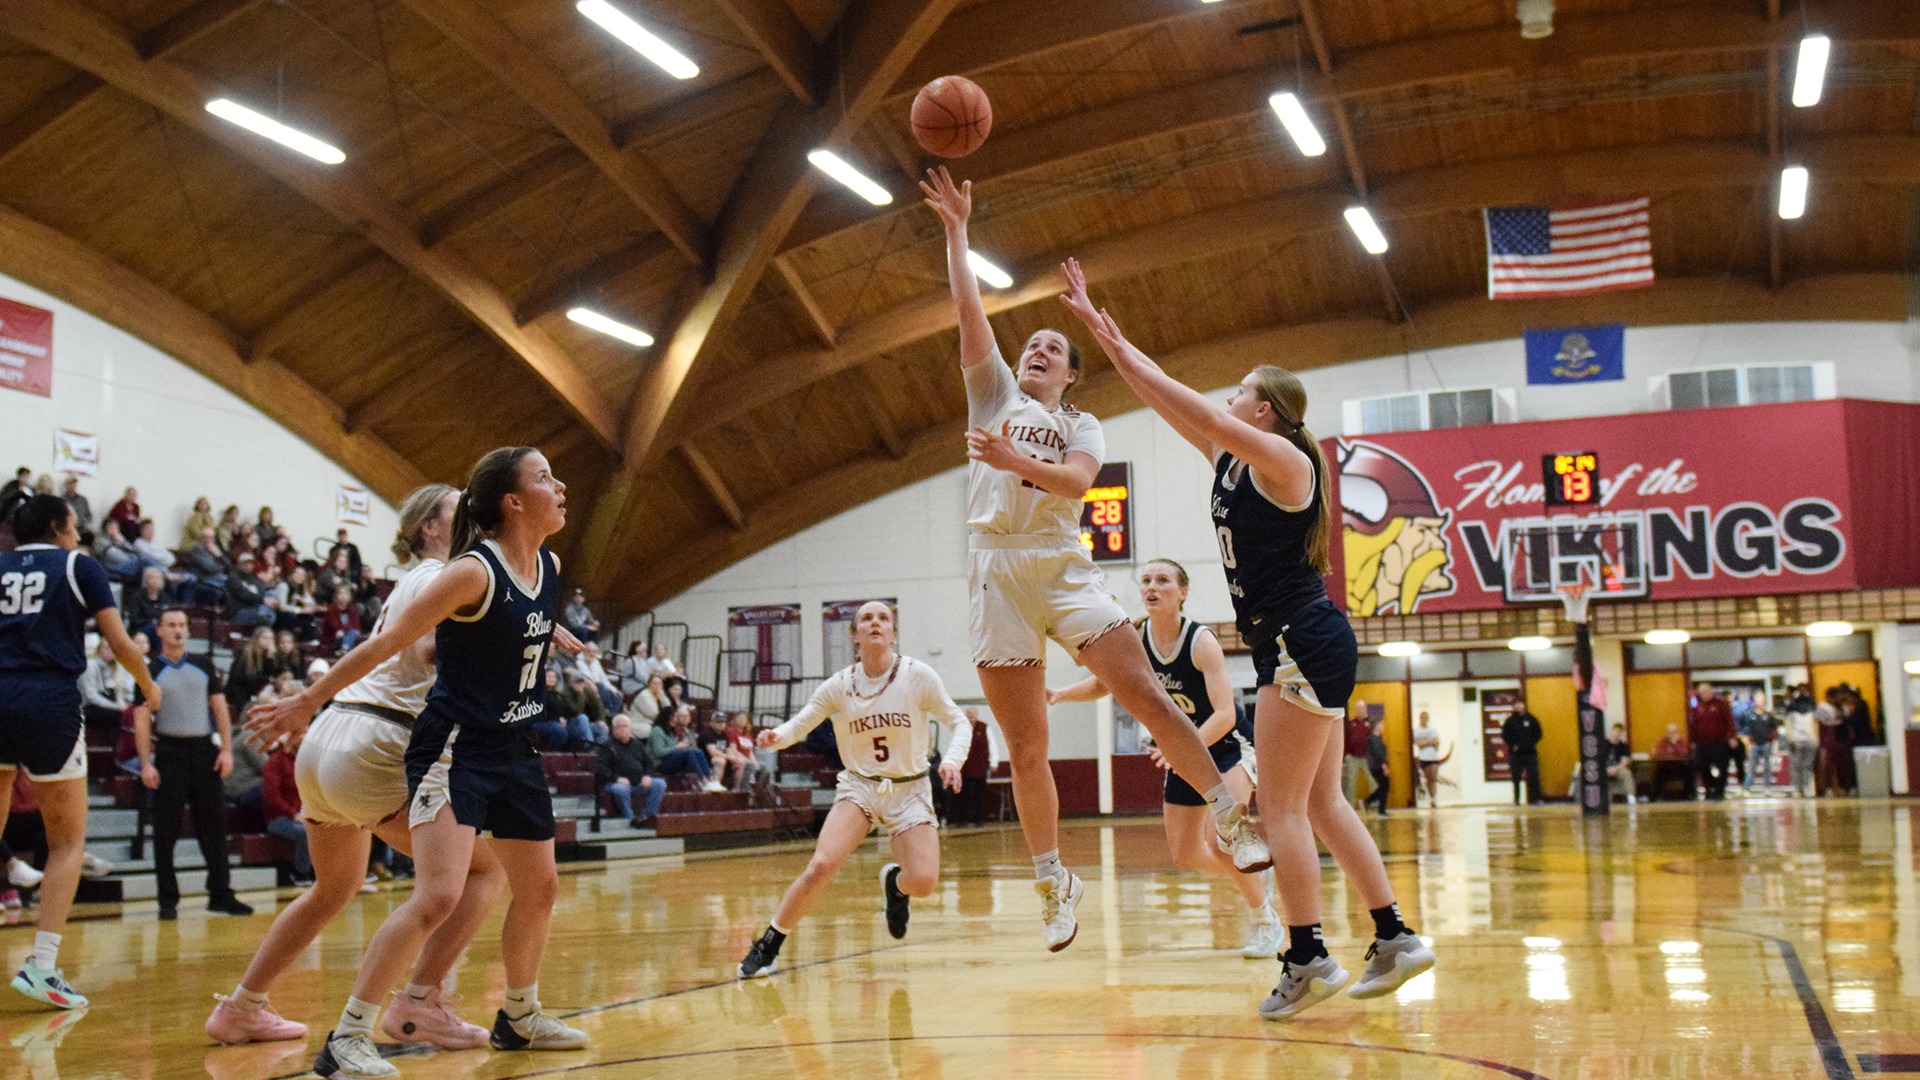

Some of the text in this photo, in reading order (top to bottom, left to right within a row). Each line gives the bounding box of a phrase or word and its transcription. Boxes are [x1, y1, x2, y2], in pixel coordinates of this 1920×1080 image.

[1454, 460, 1547, 511] Hom
[1637, 458, 1697, 496] the
[1562, 471, 1592, 502] 13
[1091, 500, 1122, 526] 28
[1107, 531, 1123, 553] 0
[1457, 497, 1846, 592] VIKINGS
[0, 571, 47, 615] 32
[523, 610, 551, 638] Blue
[872, 736, 889, 763] 5
